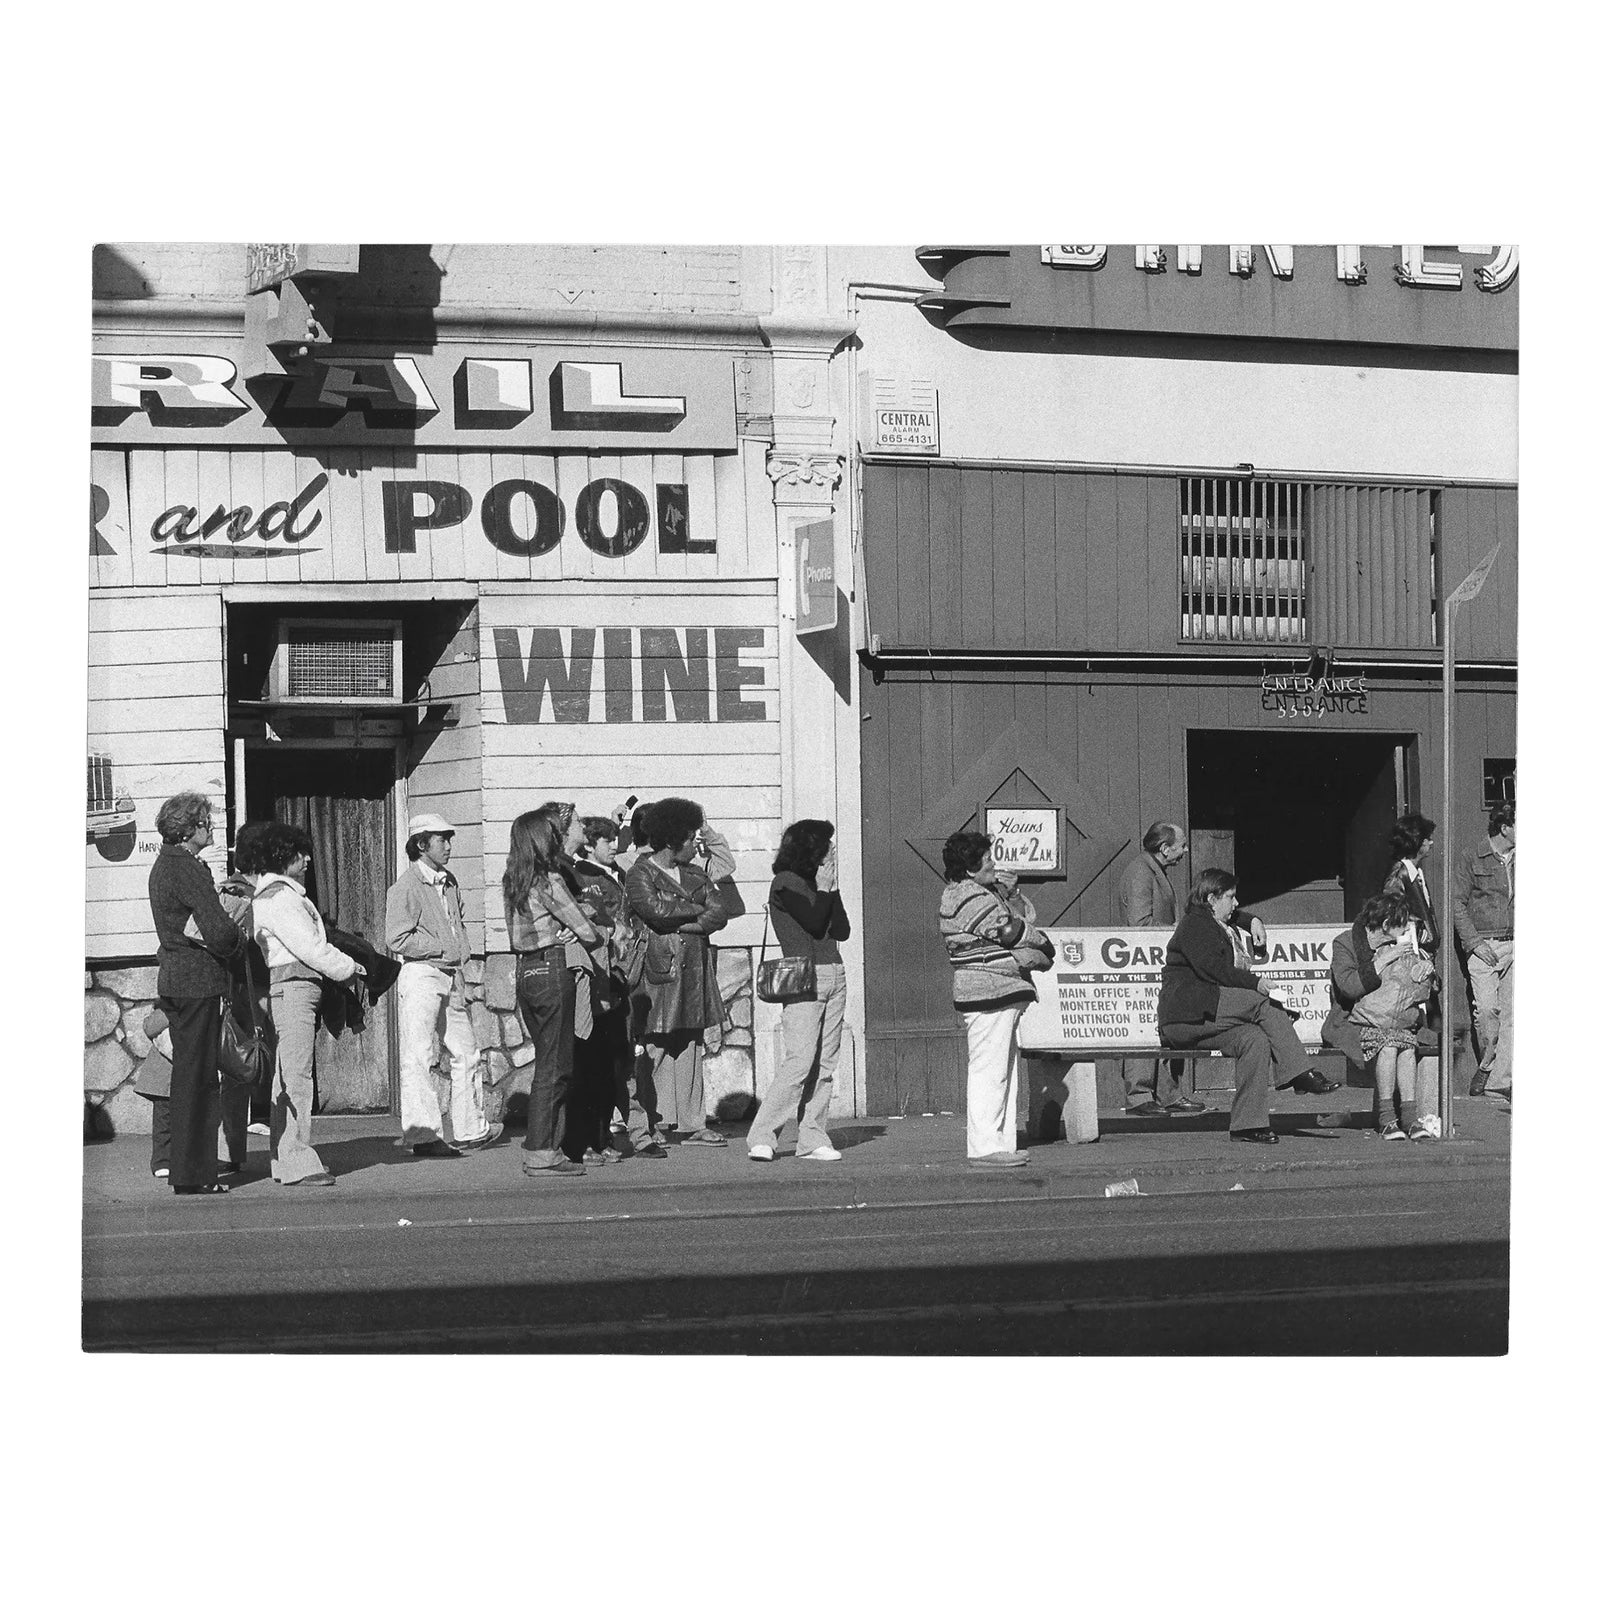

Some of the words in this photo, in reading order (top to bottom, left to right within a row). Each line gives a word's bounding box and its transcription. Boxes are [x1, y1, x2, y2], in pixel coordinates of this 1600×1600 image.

[881, 412, 931, 426] CENTRAL
[881, 434, 932, 444] 665-4131
[150, 472, 329, 544] and
[381, 478, 718, 558] POOL
[806, 566, 833, 583] Phone
[492, 627, 767, 723] WINE
[1262, 677, 1368, 693] ENTRANCE
[998, 817, 1044, 834] Hours
[1101, 937, 1166, 969] GAR
[1102, 974, 1120, 982] PAY
[1314, 970, 1327, 978] BY
[1059, 988, 1086, 998] MAIN
[1093, 988, 1131, 998] OFFICE
[1144, 987, 1160, 998] MO
[1302, 984, 1315, 994] AT
[1060, 1001, 1118, 1011] MONTEREY
[1125, 1001, 1154, 1011] PARK
[1279, 998, 1310, 1008] IELD
[1061, 1014, 1131, 1025] HUNTINGTON
[1139, 1014, 1159, 1024] BEA
[1063, 1027, 1129, 1038] HOLLYWOOD
